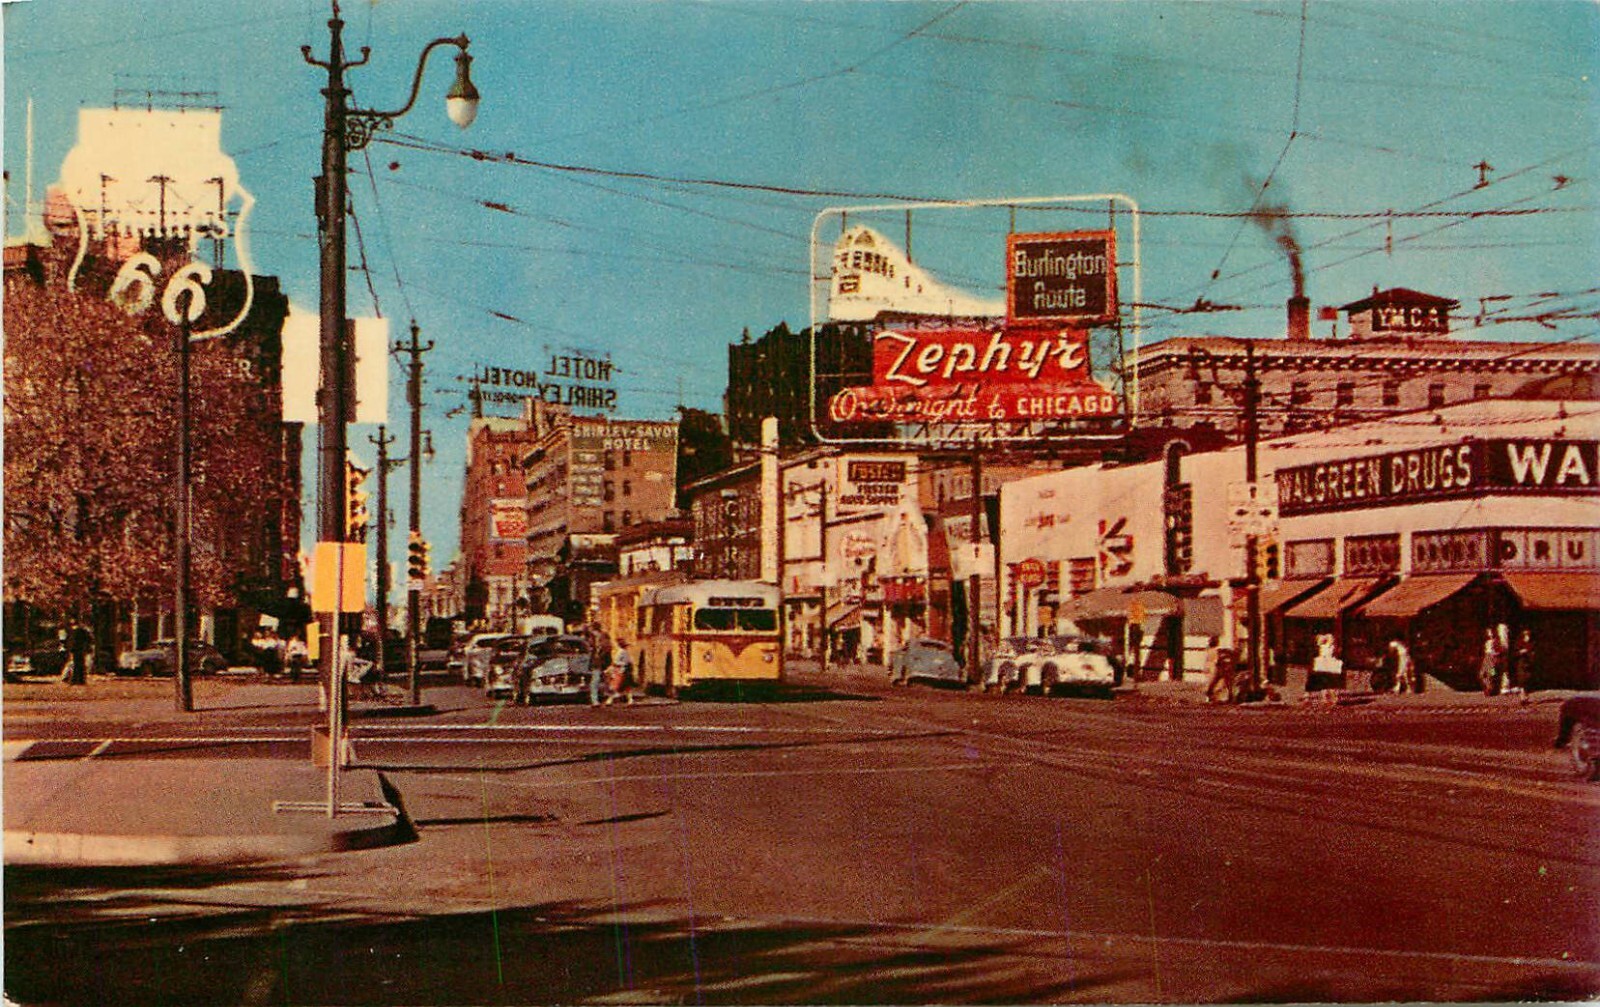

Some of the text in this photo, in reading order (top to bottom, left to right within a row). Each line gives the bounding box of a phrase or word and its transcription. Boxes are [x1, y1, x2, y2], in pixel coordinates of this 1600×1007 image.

[1014, 248, 1108, 279] Burlington
[110, 252, 213, 325] 66
[1033, 281, 1086, 310] Route
[875, 329, 1085, 386] Zephyr
[988, 393, 1007, 419] to
[1017, 394, 1115, 416] CHICAGO
[603, 438, 651, 451] HOTEL
[1278, 444, 1472, 504] WALGREEN DRUGS
